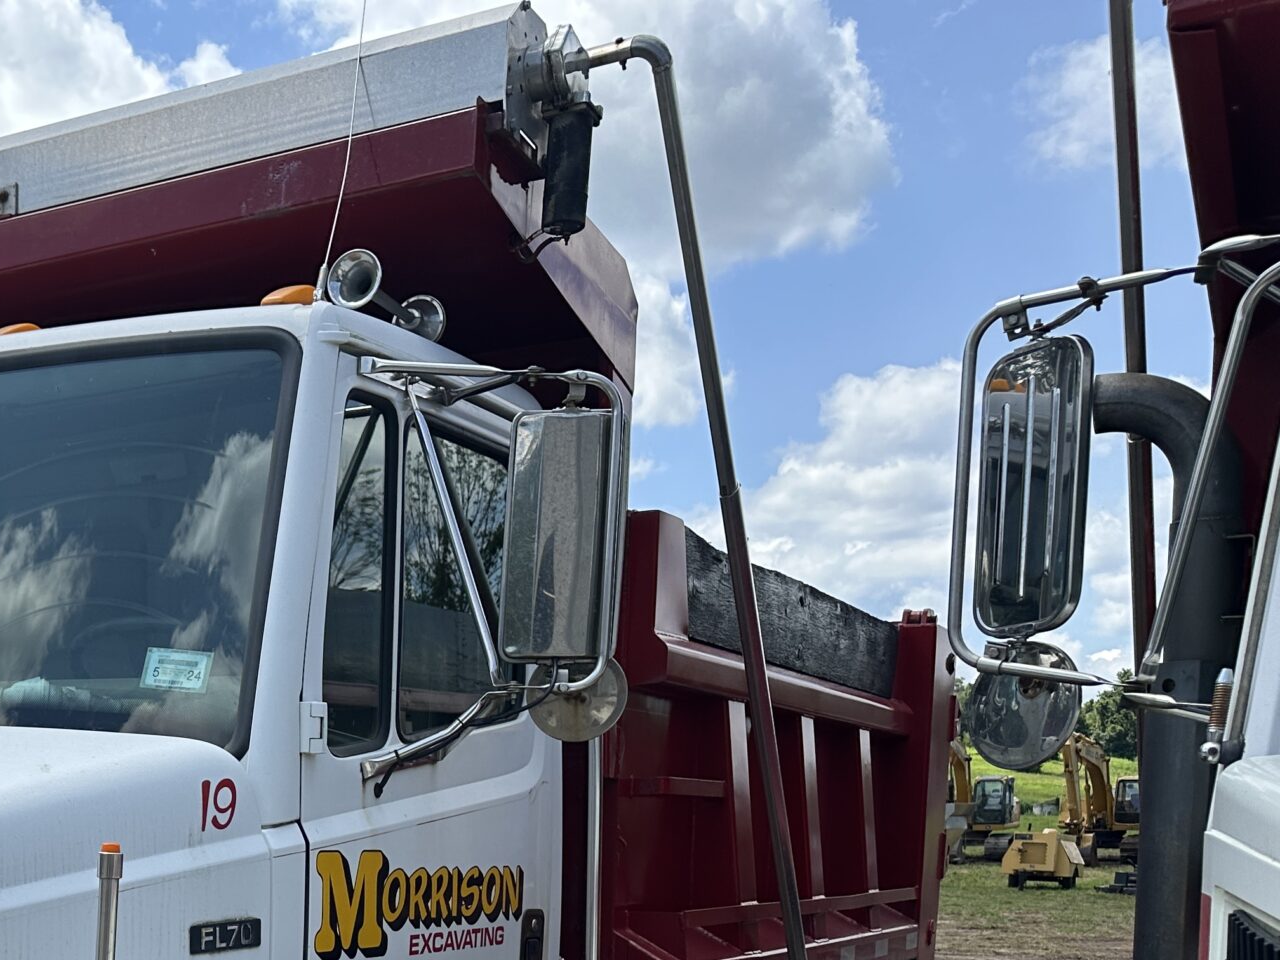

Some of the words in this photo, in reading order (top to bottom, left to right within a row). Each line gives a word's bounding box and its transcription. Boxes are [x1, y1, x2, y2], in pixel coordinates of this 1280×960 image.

[152, 666, 161, 678] 5
[186, 670, 202, 682] 24
[201, 778, 237, 832] 19
[200, 922, 253, 951] FL70
[408, 925, 505, 956] EXCAVATING
